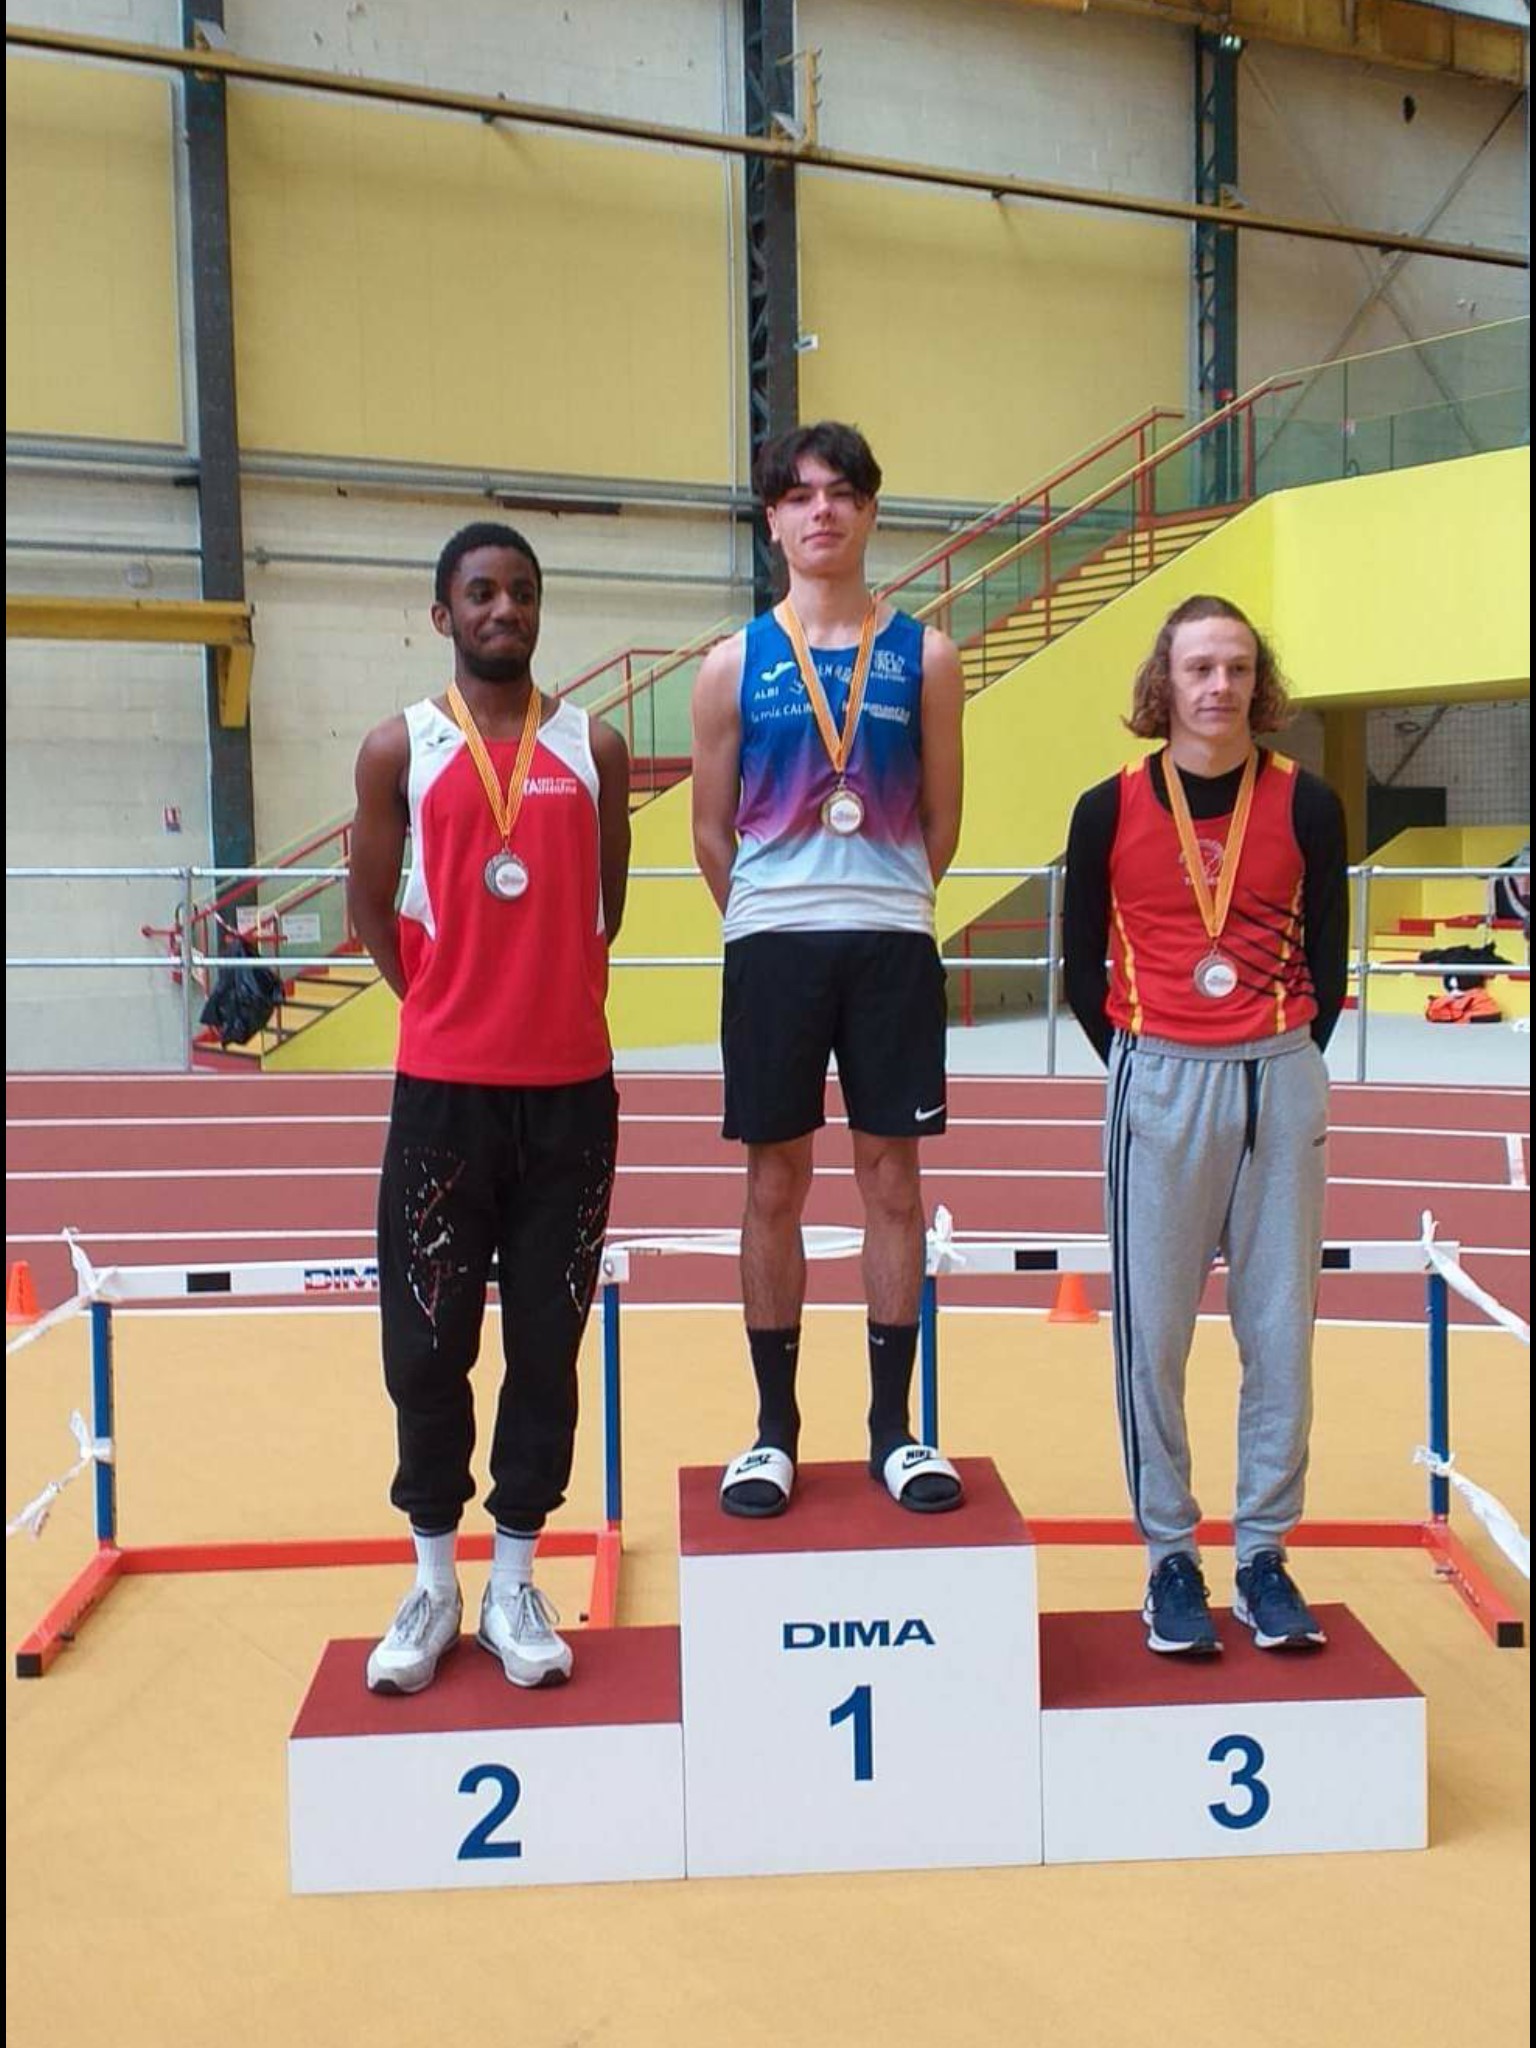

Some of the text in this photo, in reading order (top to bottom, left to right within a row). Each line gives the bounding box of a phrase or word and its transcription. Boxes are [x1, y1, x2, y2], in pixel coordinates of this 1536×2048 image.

[754, 686, 780, 701] ALBI
[783, 702, 813, 716] CALIN
[304, 1267, 378, 1290] DIM
[906, 1450, 931, 1461] NIKE
[783, 1619, 936, 1649] DIMA
[830, 1685, 873, 1781] 1
[1208, 1734, 1270, 1829] 3
[457, 1764, 522, 1859] 2
